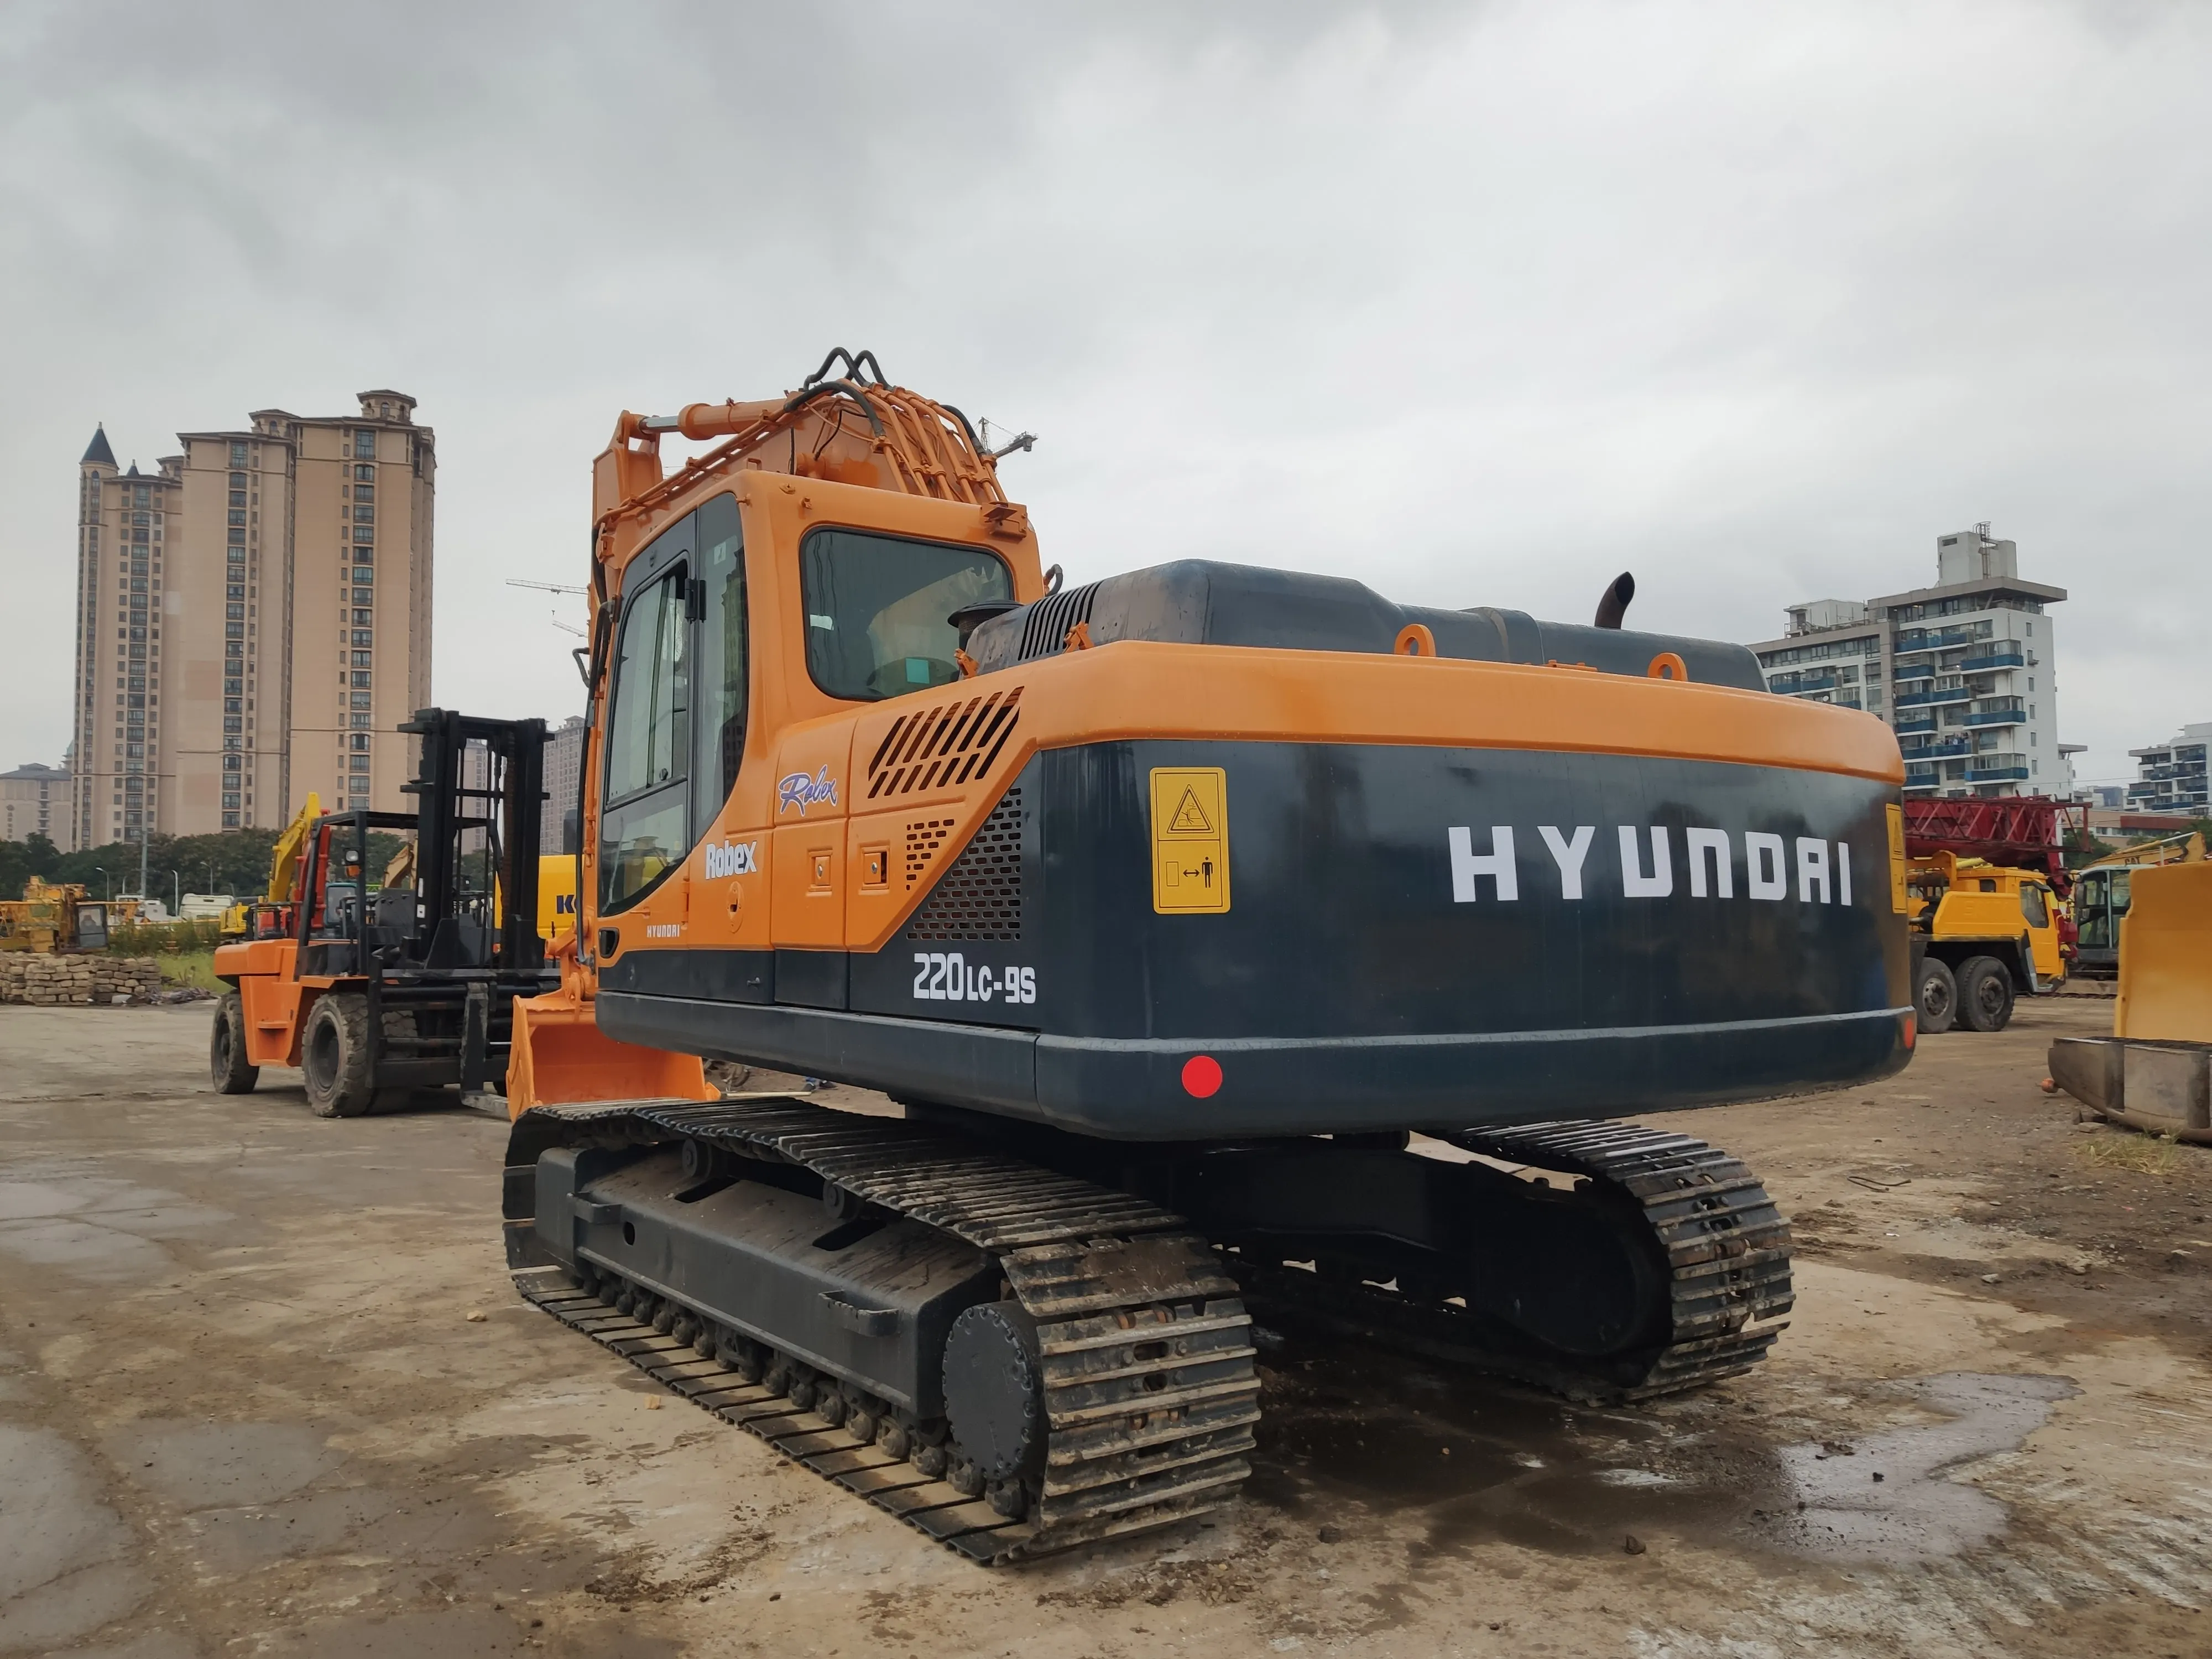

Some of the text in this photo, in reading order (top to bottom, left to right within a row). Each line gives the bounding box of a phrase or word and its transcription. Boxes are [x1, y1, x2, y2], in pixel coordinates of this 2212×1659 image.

[705, 839, 758, 880] Robex
[1448, 825, 1852, 906] HYUNDAI
[2125, 855, 2141, 865] CAT
[646, 924, 680, 937] HYUNDAI
